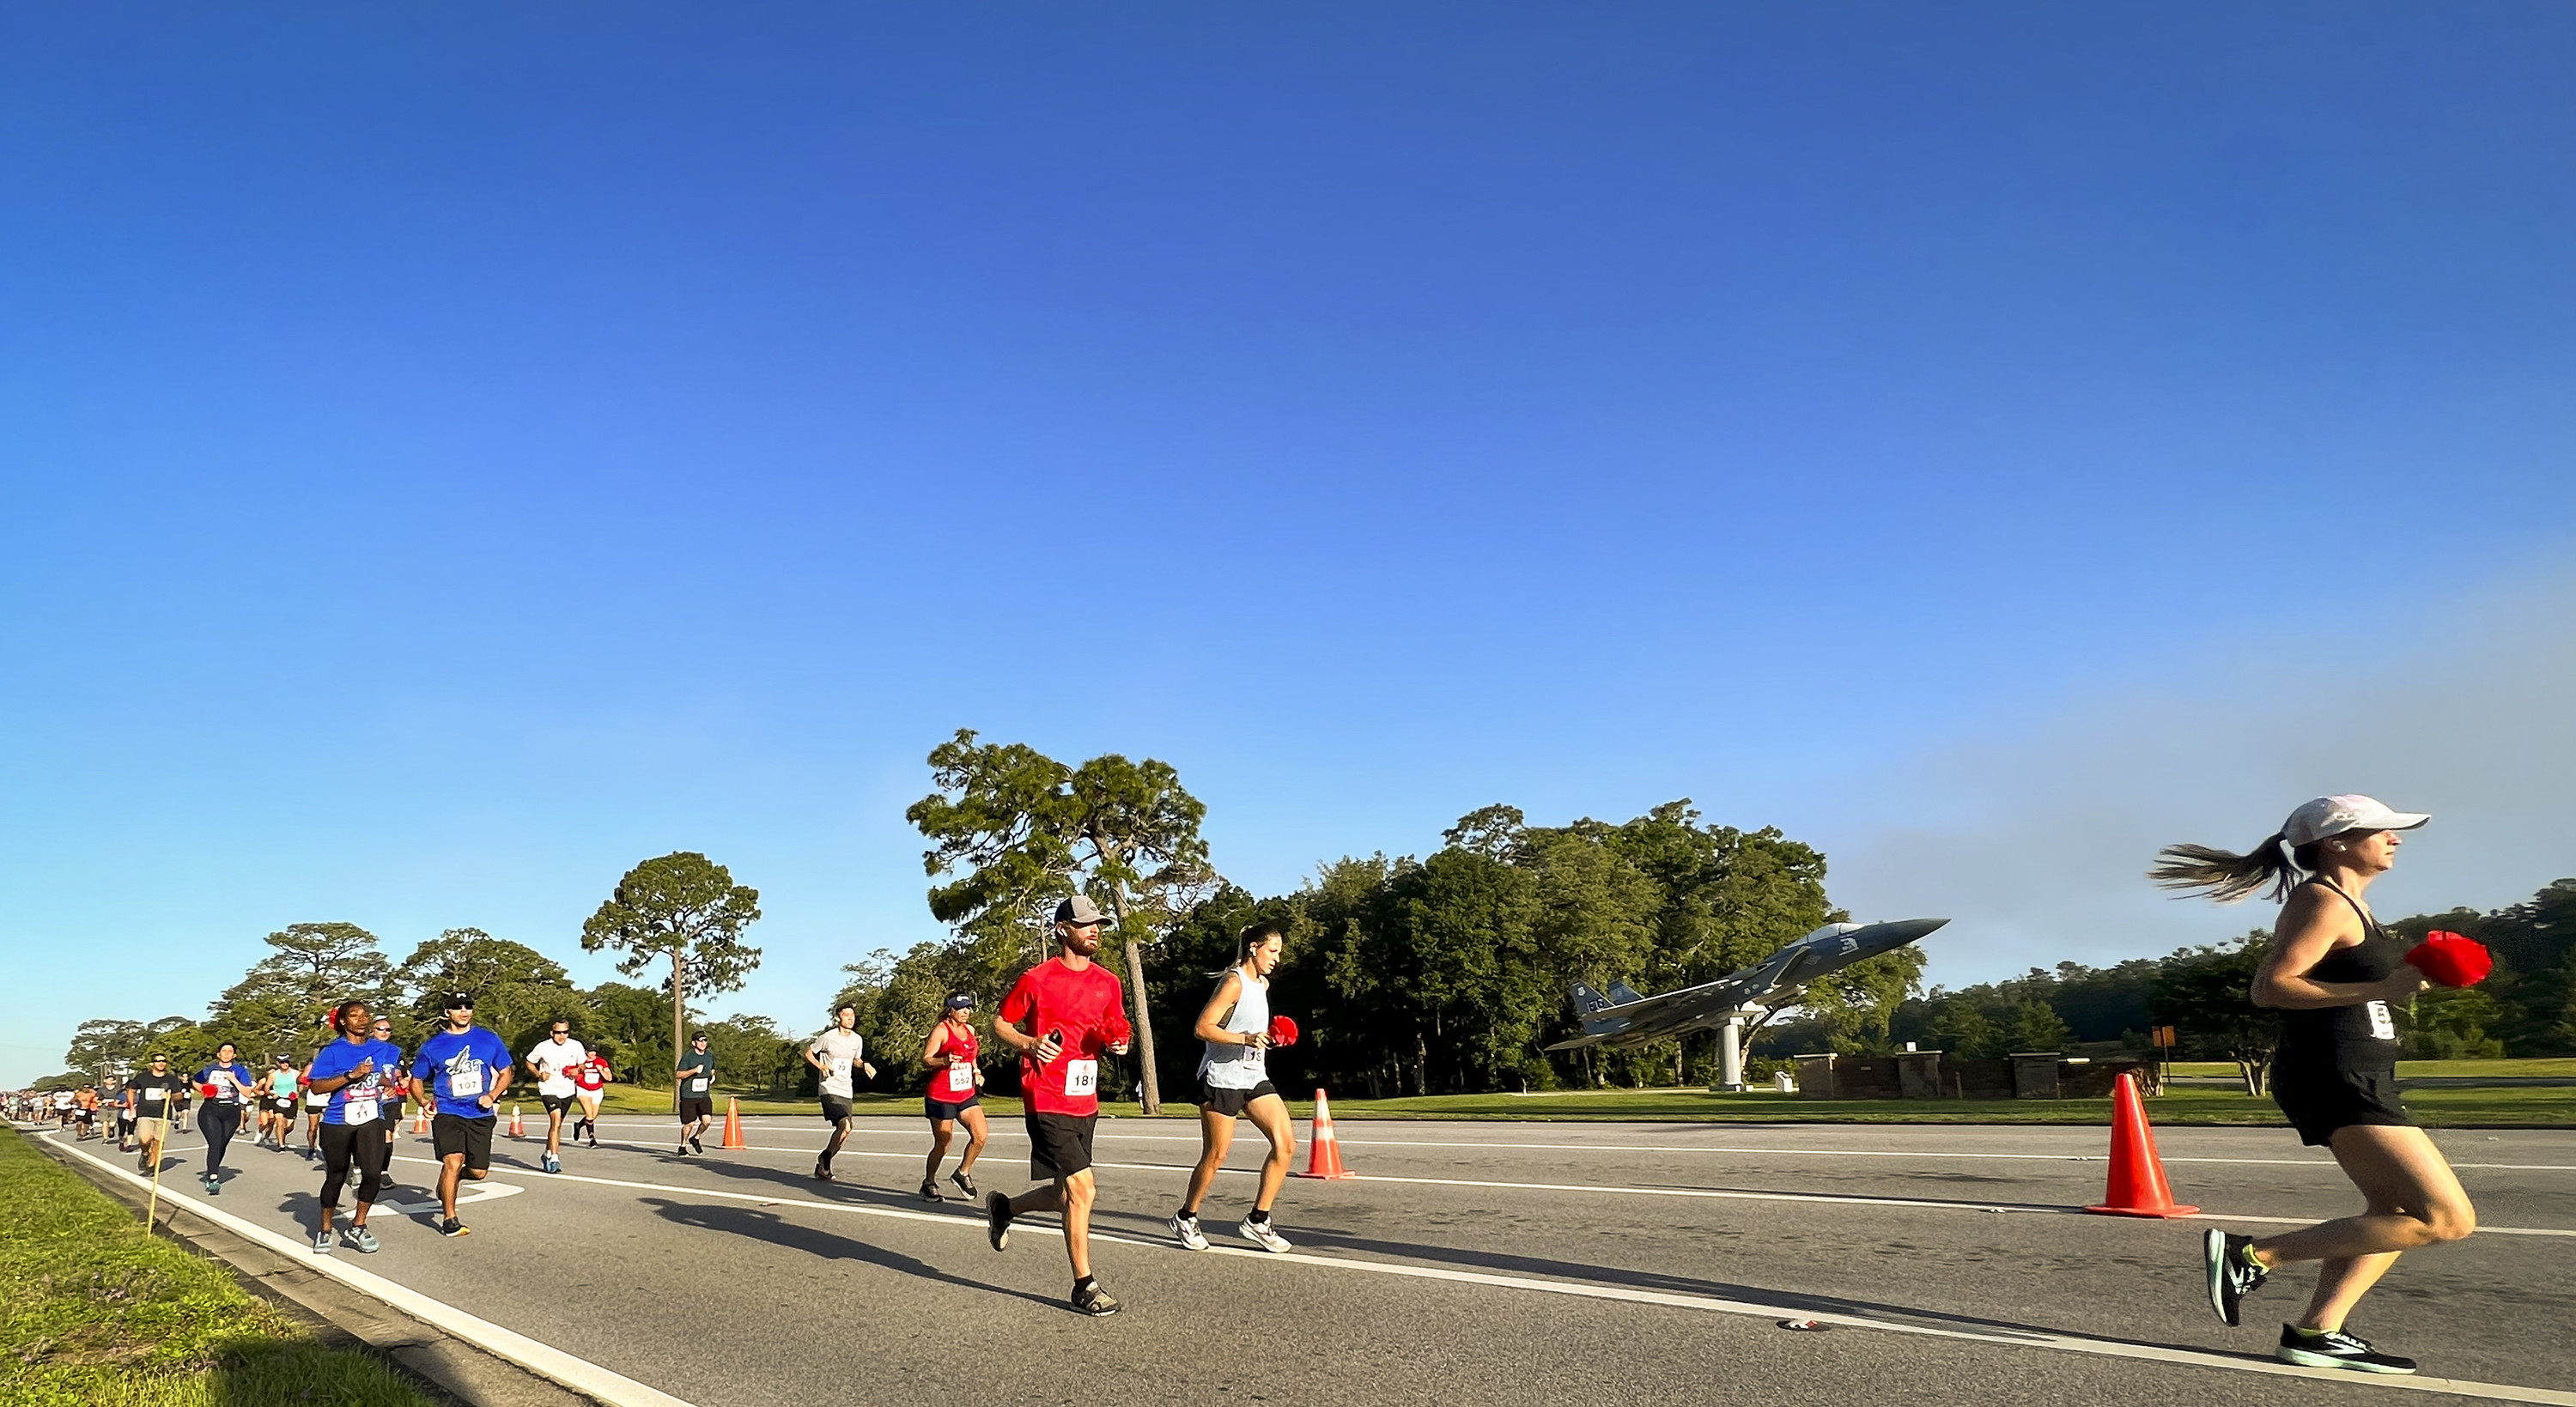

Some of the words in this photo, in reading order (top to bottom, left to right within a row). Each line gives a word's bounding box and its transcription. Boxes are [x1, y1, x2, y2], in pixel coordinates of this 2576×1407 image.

[465, 1059, 481, 1073] 35
[458, 1081, 477, 1090] 107
[1074, 1075, 1095, 1087] 181
